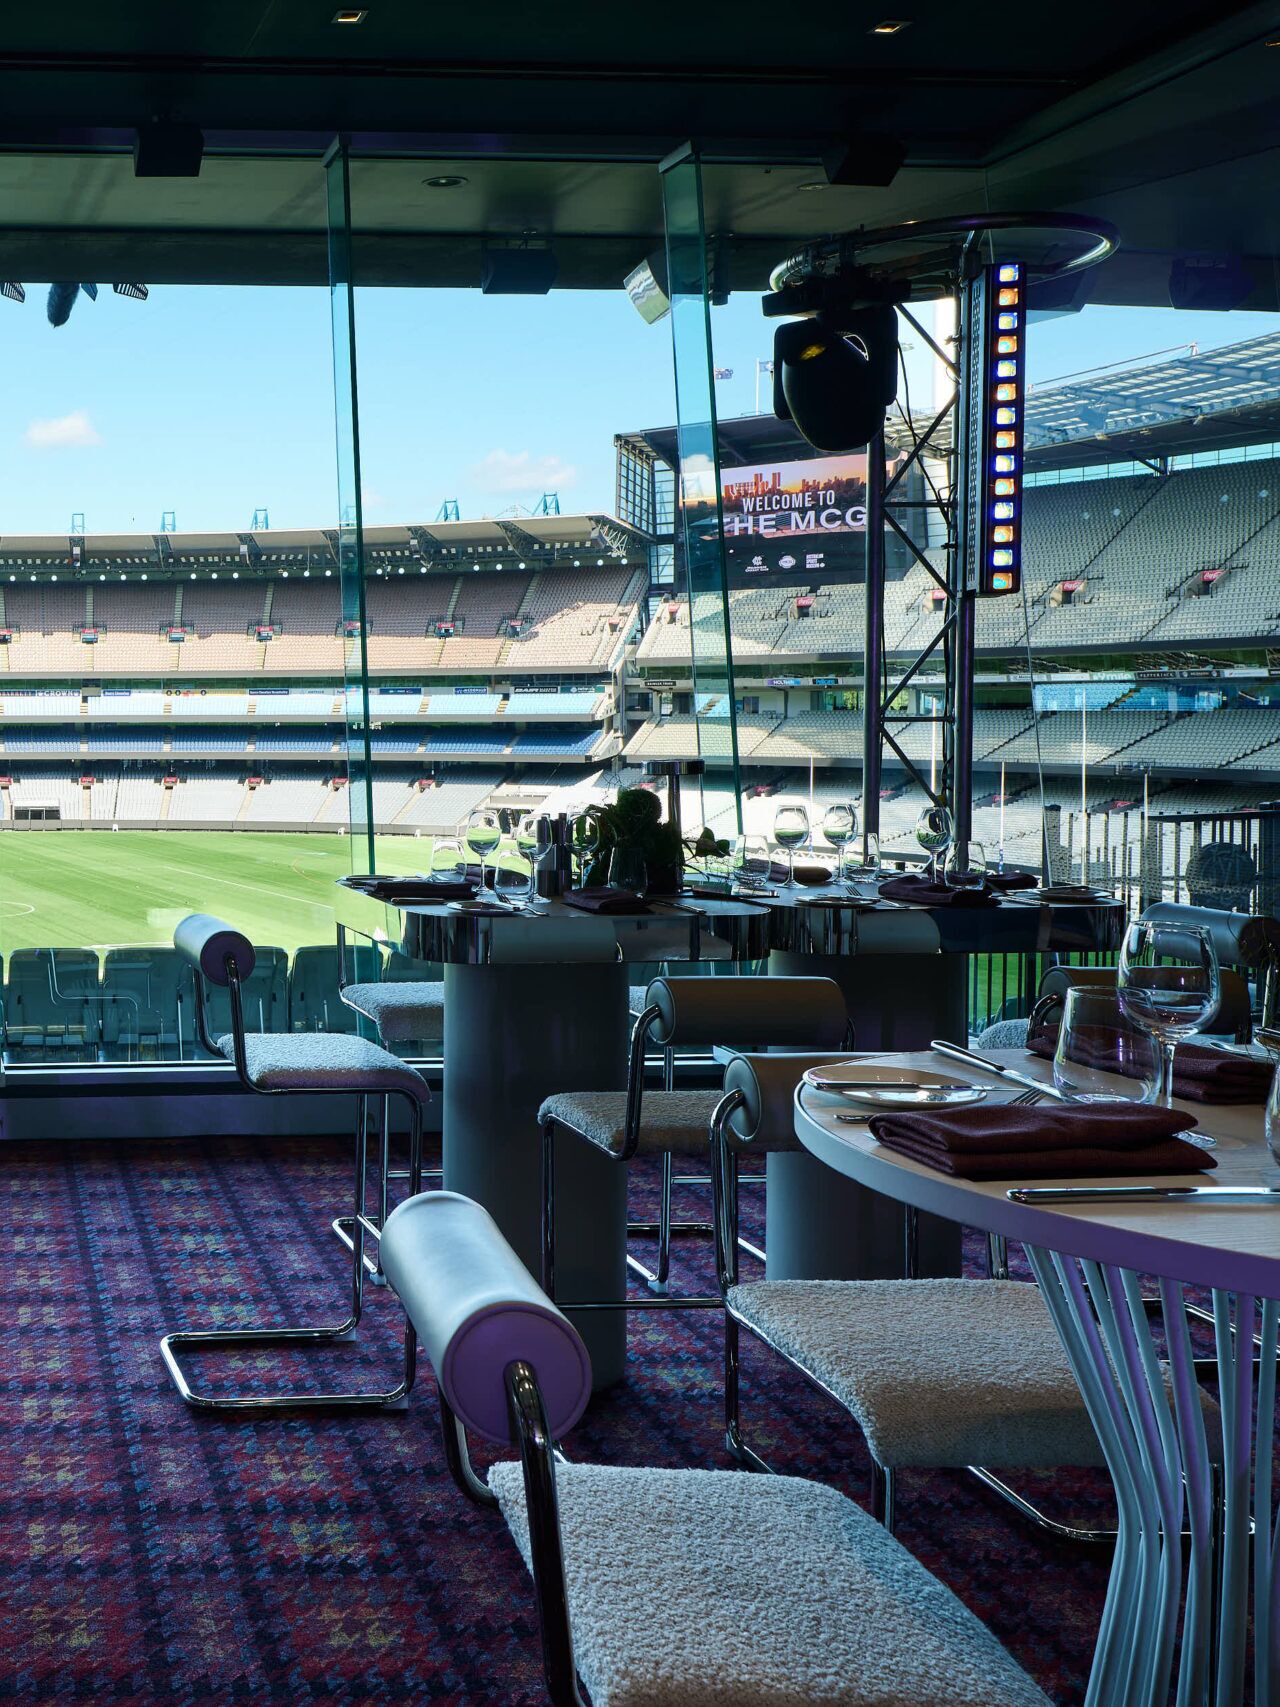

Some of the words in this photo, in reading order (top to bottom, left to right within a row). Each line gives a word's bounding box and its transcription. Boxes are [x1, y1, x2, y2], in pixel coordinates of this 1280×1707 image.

[742, 493, 812, 512] WELCOME
[818, 490, 835, 506] TO
[790, 505, 867, 531] MCG
